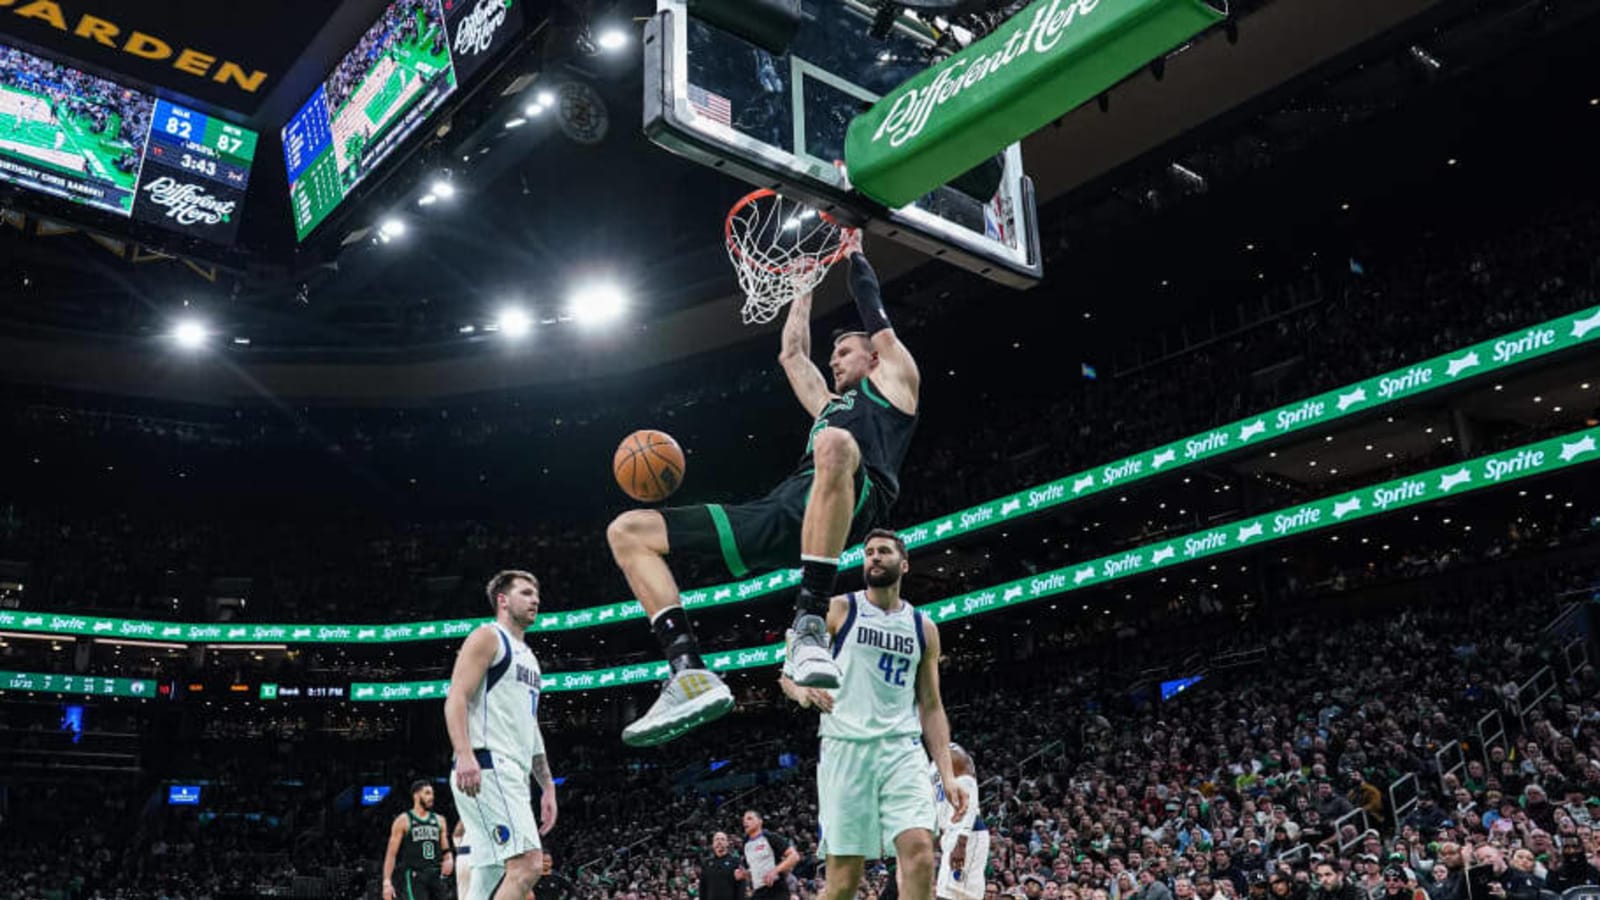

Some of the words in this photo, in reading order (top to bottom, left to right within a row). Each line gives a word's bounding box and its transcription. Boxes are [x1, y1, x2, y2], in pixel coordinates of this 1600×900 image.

[872, 30, 1026, 147] Different
[165, 116, 192, 139] 82
[217, 134, 244, 154] 87
[180, 153, 216, 176] 3:43
[143, 176, 236, 214] Different
[165, 202, 222, 224] Here
[49, 617, 87, 633] Sprite
[119, 622, 156, 638] Sprite
[187, 626, 222, 641] Sprite
[252, 626, 287, 640] Sprite
[316, 626, 351, 640] Sprite
[381, 625, 413, 641] Sprite
[441, 621, 473, 635] Sprite
[565, 609, 594, 627] Sprite
[737, 578, 764, 597] Sprite
[840, 546, 865, 567] Sprit
[959, 506, 994, 529] Sprite
[1027, 482, 1065, 508] Sprite
[1102, 457, 1143, 485] Sprite
[1184, 430, 1230, 459] Sprite
[1275, 400, 1326, 432] Sprite
[1378, 366, 1433, 398] Sprite
[1492, 328, 1556, 363] Sprite
[381, 685, 412, 700] Sprite
[562, 672, 595, 689] Sprite
[621, 664, 651, 681] Sprite
[736, 648, 769, 666] Sprite
[962, 590, 996, 611] Sprite
[1029, 573, 1066, 596] Sprite
[1102, 552, 1143, 577] Sprite
[1183, 531, 1228, 558] Sprite
[1272, 507, 1322, 534] Sprite
[1372, 480, 1427, 509] Sprite
[1483, 449, 1545, 481] Sprite
[856, 625, 915, 655] DALLAS
[877, 651, 911, 687] 42
[328, 687, 344, 697] PM
